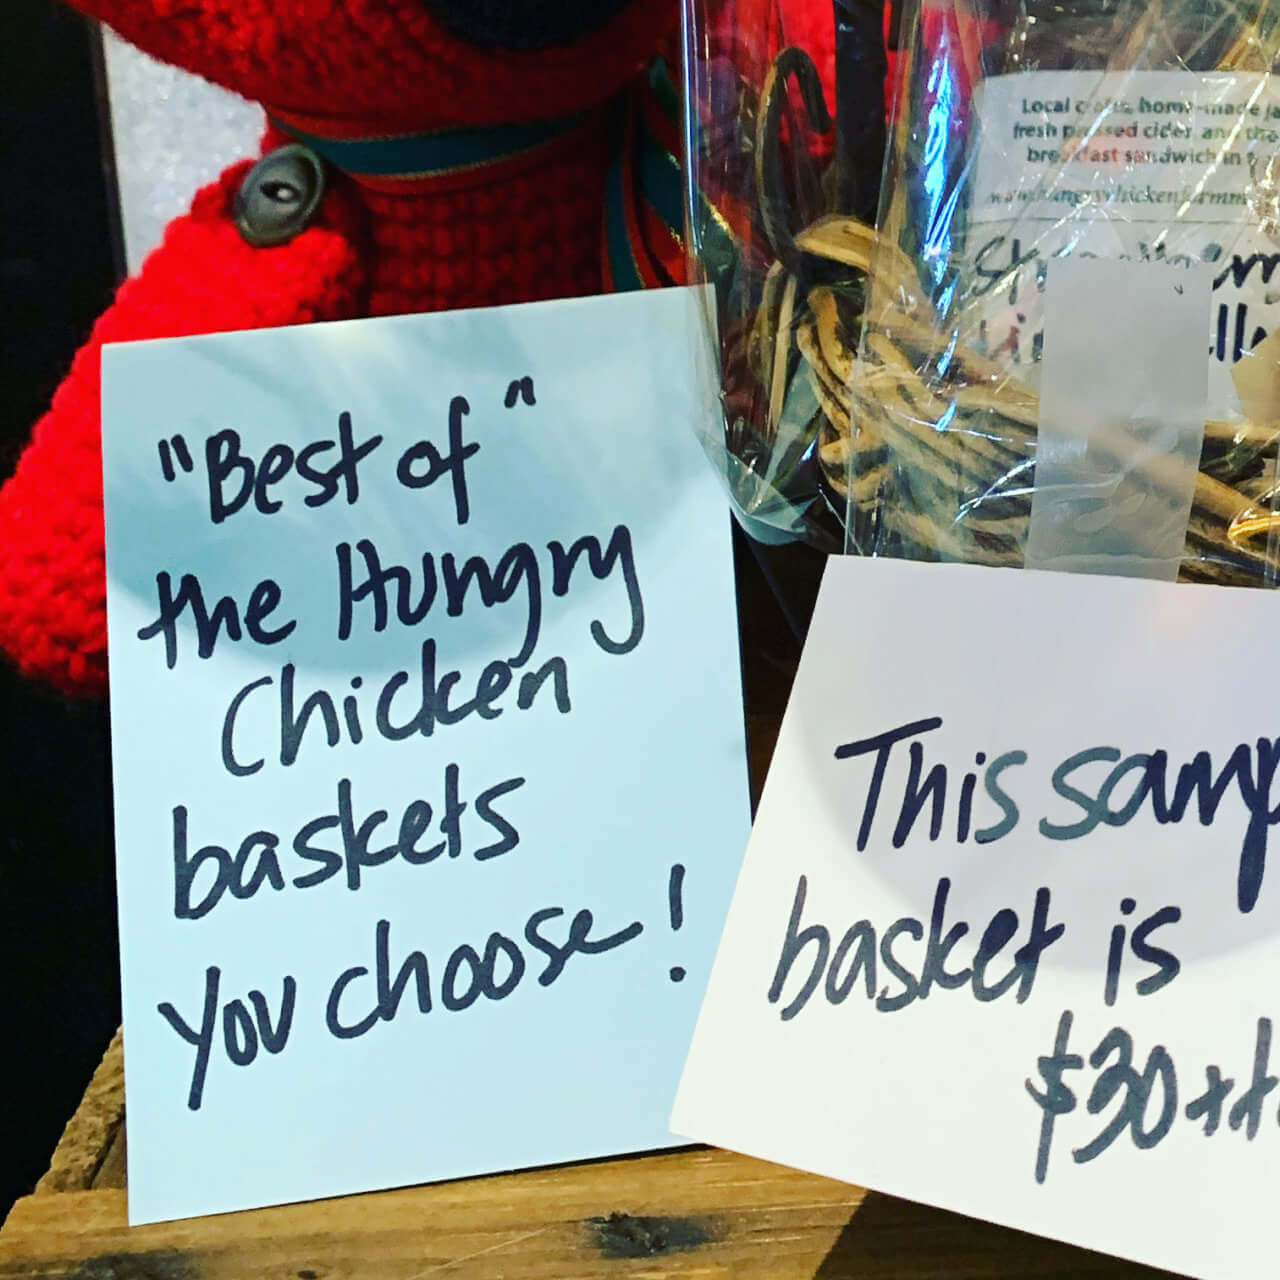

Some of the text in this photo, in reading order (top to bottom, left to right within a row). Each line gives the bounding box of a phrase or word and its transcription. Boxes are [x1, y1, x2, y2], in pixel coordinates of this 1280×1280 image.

[1013, 121, 1058, 139] fresh
[1062, 120, 1138, 141] prsed
[1201, 125, 1238, 140] an
[1021, 96, 1070, 114] Local
[1027, 144, 1119, 163] brefast
[136, 523, 645, 670] the Hungry
[220, 639, 571, 777] Chicken
[172, 762, 527, 920] baskets
[833, 715, 1030, 853] This
[766, 875, 1183, 1022] basket is
